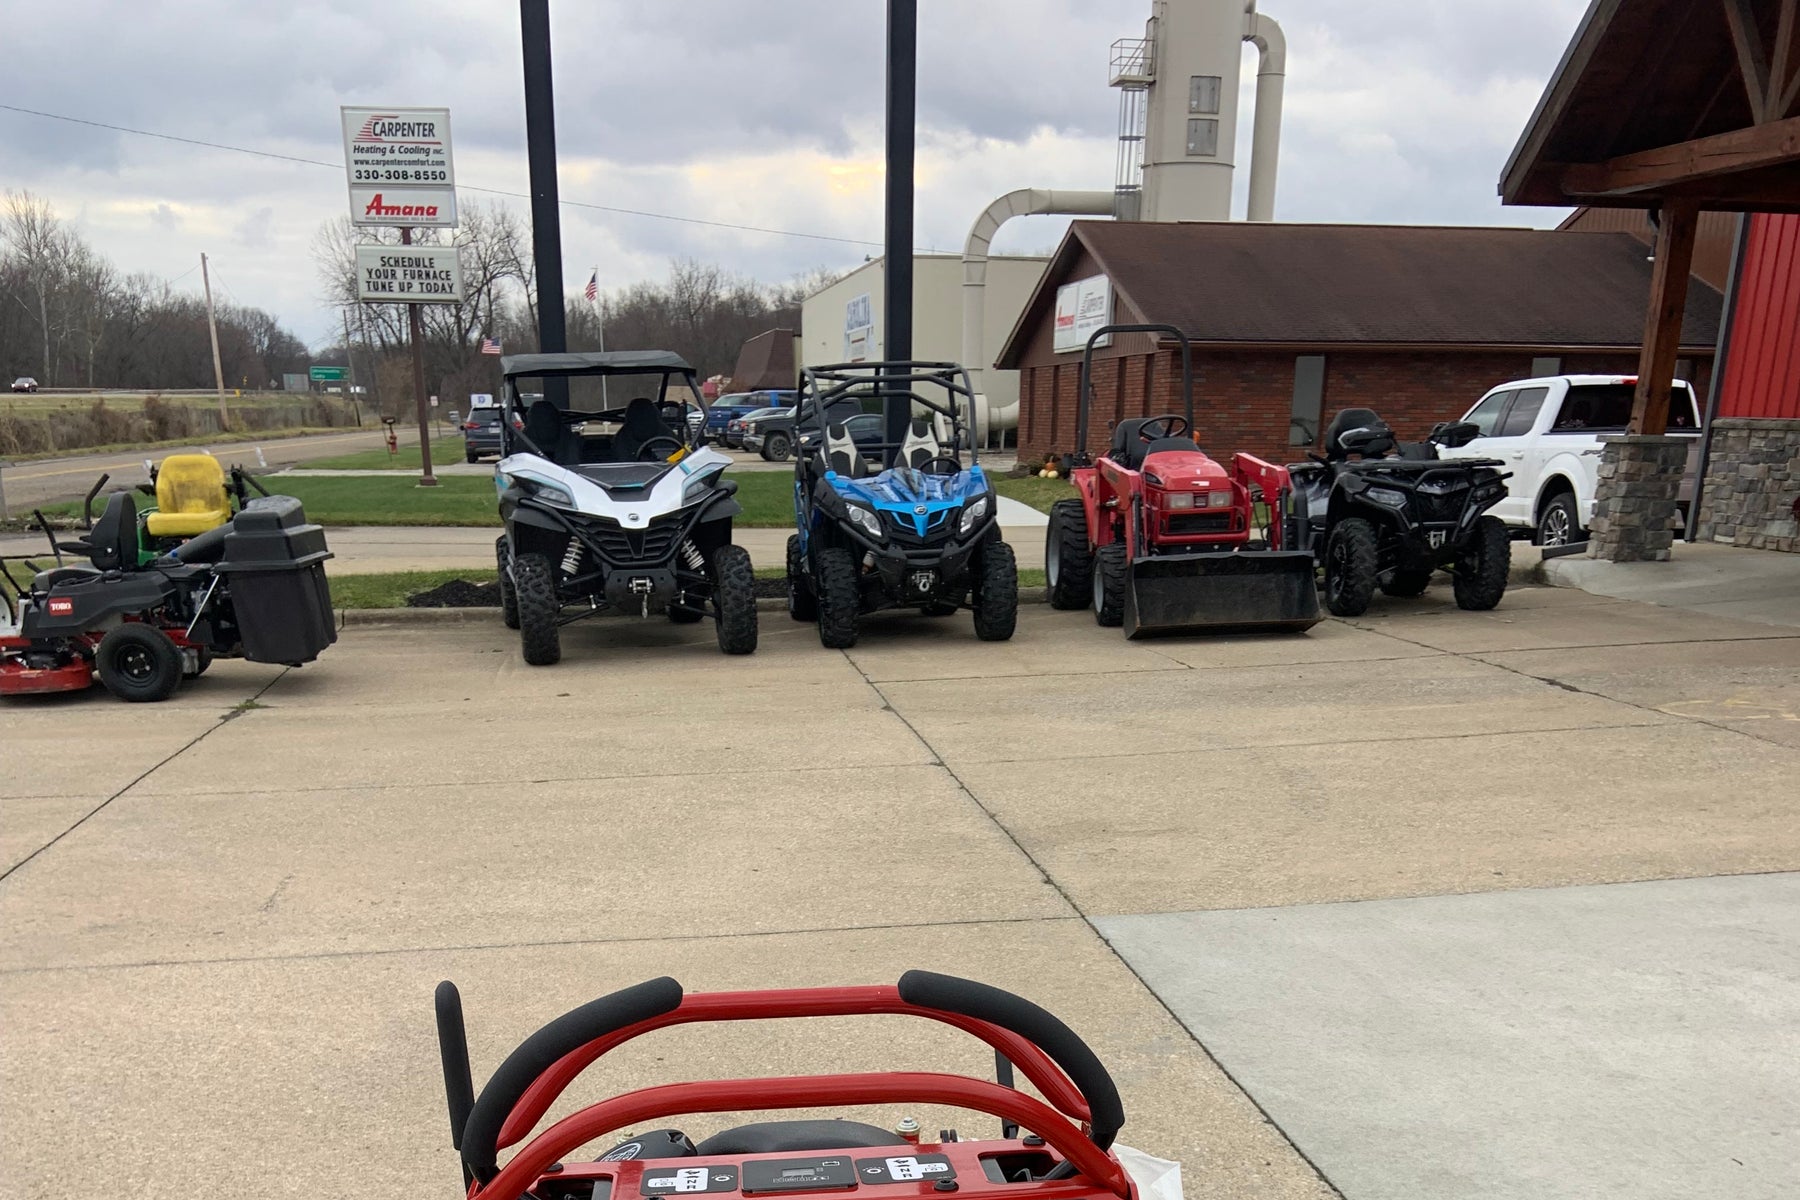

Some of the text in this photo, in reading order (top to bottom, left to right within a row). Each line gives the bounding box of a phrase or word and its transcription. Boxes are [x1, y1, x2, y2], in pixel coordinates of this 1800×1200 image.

[372, 122, 435, 137] CARPENTER
[353, 145, 387, 156] Heating
[389, 145, 395, 154] &
[398, 145, 431, 157] Cooling
[353, 158, 446, 167] www.carpentercomfort.com
[365, 193, 438, 216] Amana
[380, 256, 434, 268] SCHEDULE
[366, 268, 451, 280] YOUR FURNACE
[366, 281, 454, 293] TUNE UP TODAY
[50, 602, 72, 611] TORO
